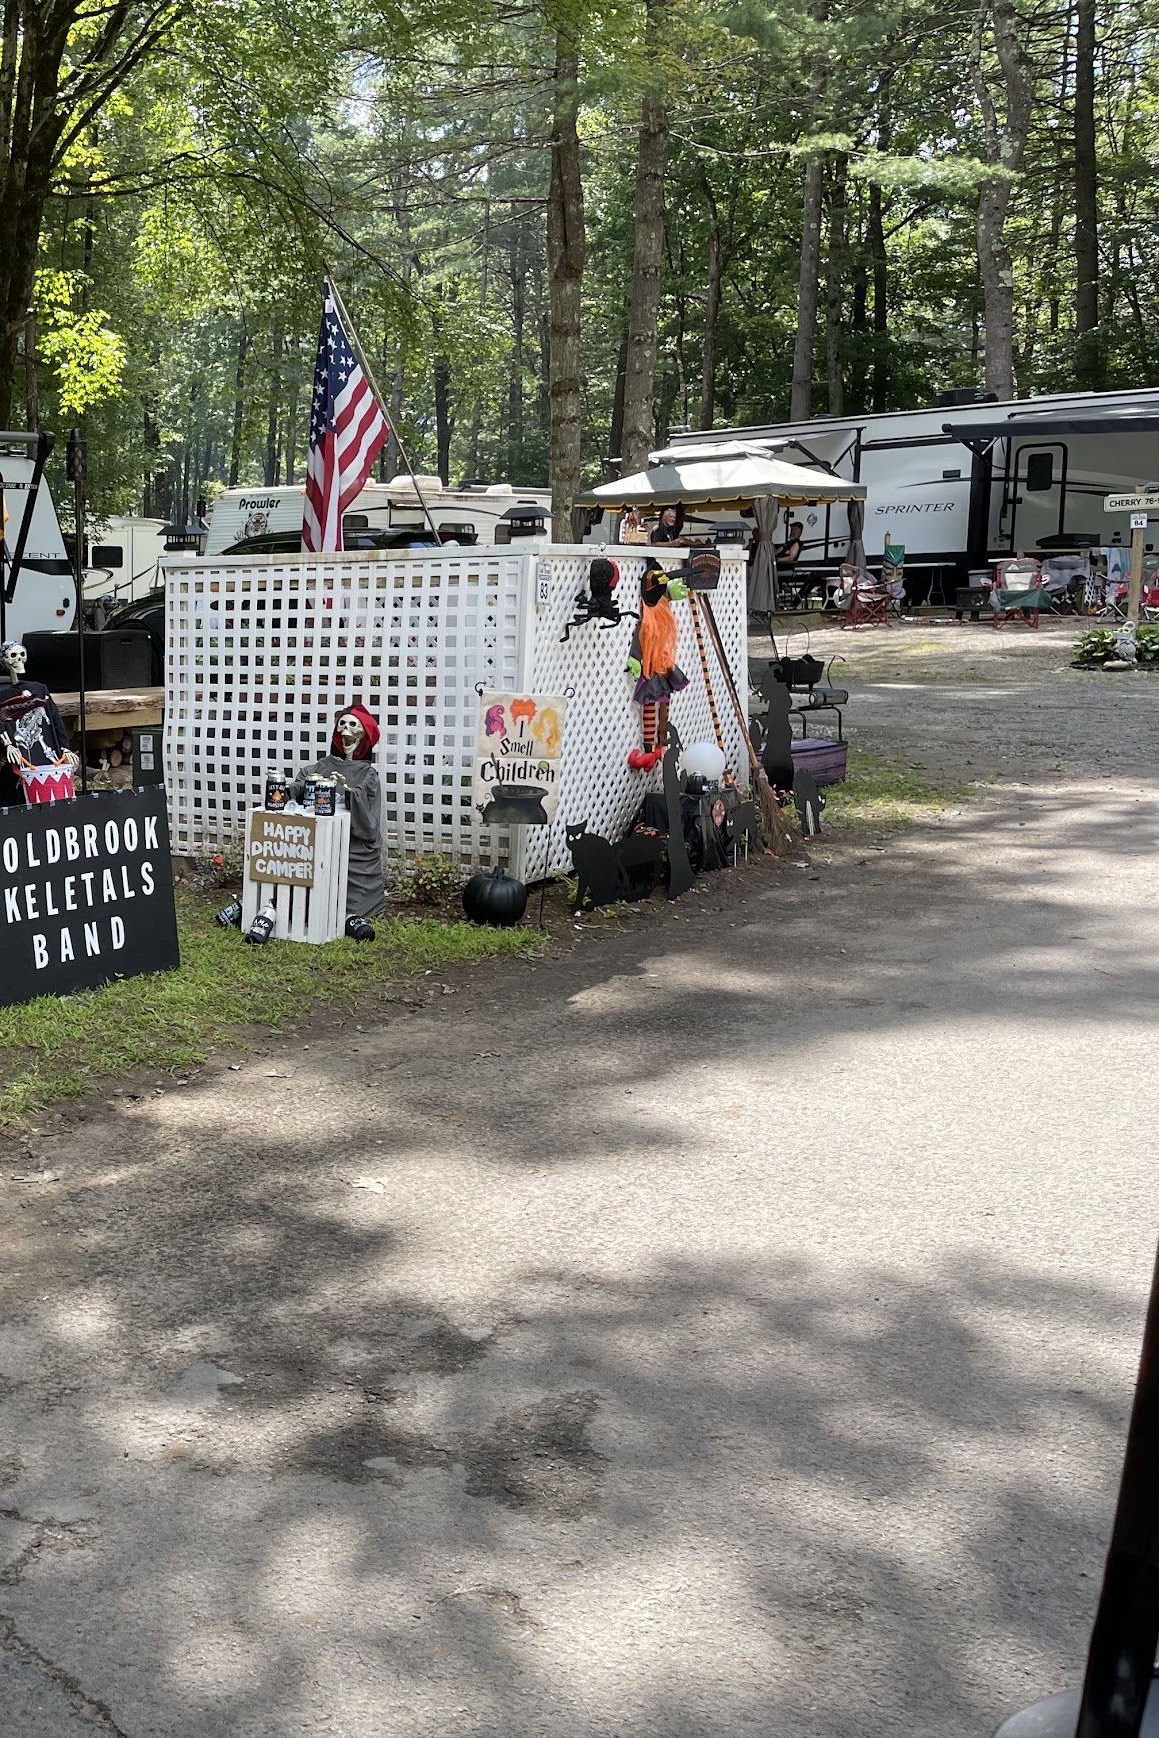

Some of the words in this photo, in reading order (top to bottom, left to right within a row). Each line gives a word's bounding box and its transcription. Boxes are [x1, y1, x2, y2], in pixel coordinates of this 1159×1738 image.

[238, 497, 281, 510] Prowler
[874, 502, 955, 515] SPRINTER
[1109, 498, 1141, 508] CHERRY
[540, 582, 548, 600] 83
[519, 720, 525, 738] I
[499, 737, 534, 757] Smell
[480, 759, 555, 783] Children
[263, 821, 311, 847] HAPPY
[251, 840, 314, 861] DRUNKIN
[255, 858, 313, 880] CAMPER
[33, 916, 126, 970] BAND
